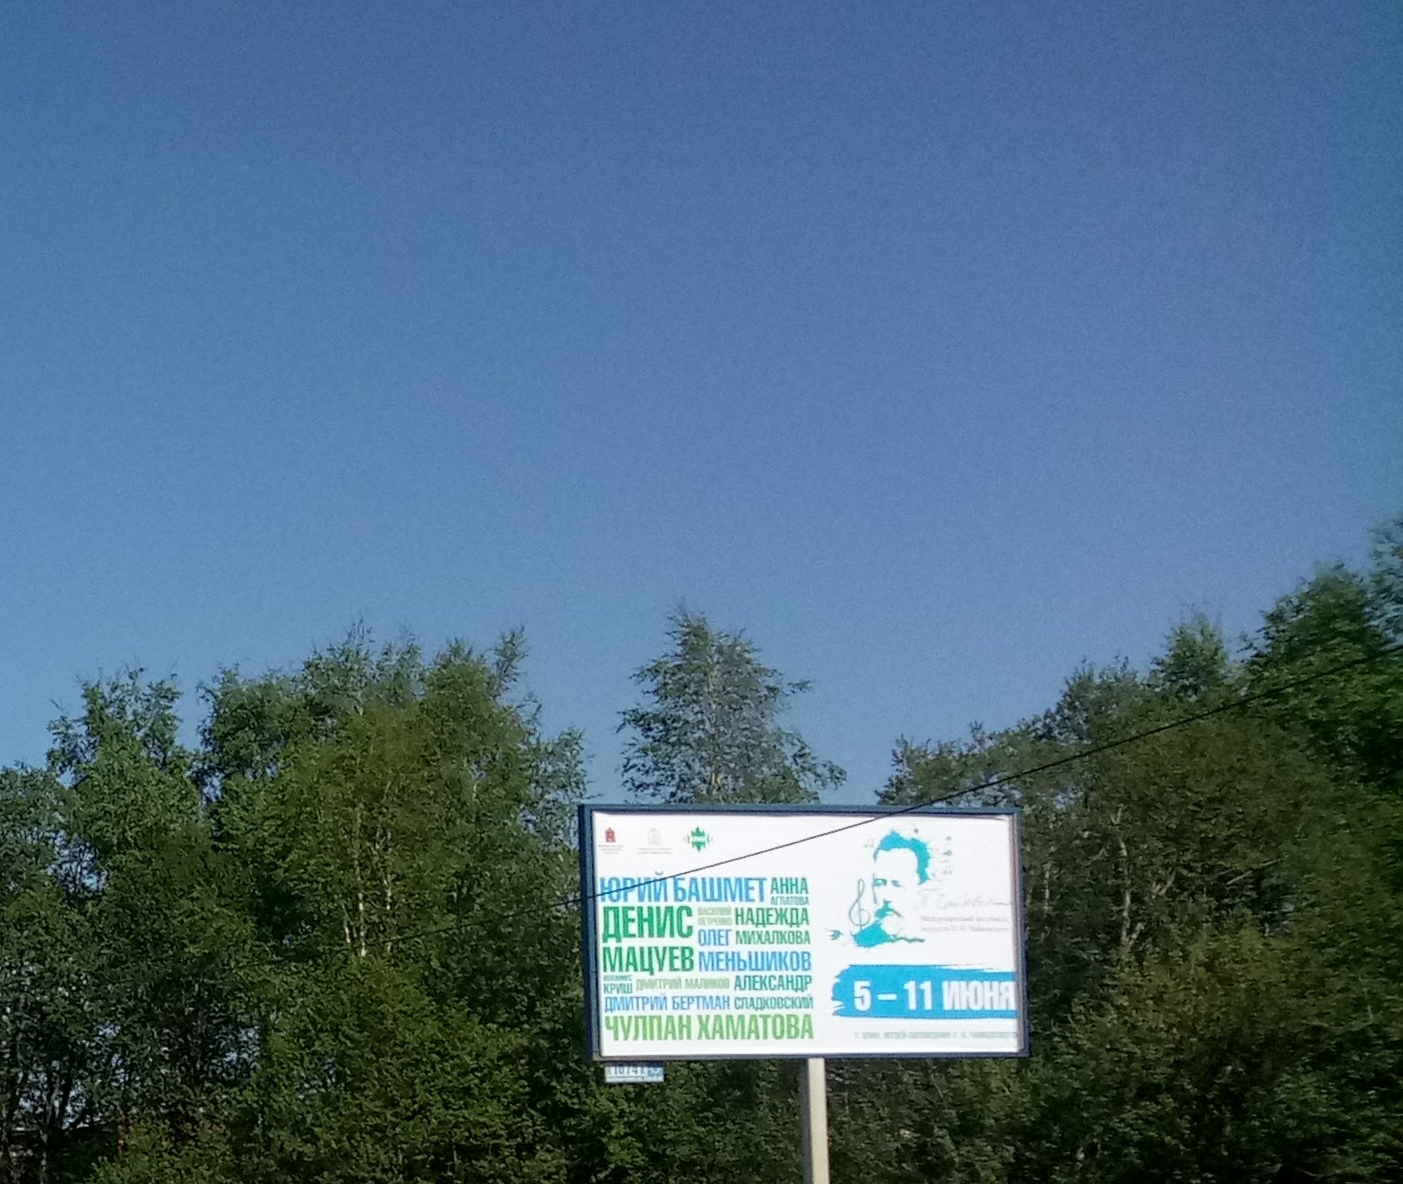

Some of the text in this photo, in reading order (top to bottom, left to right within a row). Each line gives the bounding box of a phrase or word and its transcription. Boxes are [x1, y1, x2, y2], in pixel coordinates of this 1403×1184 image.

[599, 870, 767, 902] ЮРИЙ БАШМЕТ
[770, 877, 809, 894] АННА
[602, 905, 694, 943] ДЕНИС
[735, 907, 810, 928] НАДЕЖДА
[698, 928, 732, 946] ОЛЕГ
[735, 930, 811, 945] МИХАЛКОВА
[602, 946, 695, 976] МАЦУЕВ
[698, 951, 812, 971] МЕНЬШИКОВ
[734, 975, 812, 992] АЛЕКСАНДР
[604, 993, 730, 1013] ДМИТРИЙ БЕРТМАН
[734, 994, 814, 1011] СЛАДКОВСКИЙ
[853, 980, 872, 1011] 5
[903, 980, 933, 1011] 11
[942, 980, 1016, 1011] ИЮНЯ
[605, 1014, 814, 1041] ЧУЛПАН ХАМАТОВА
